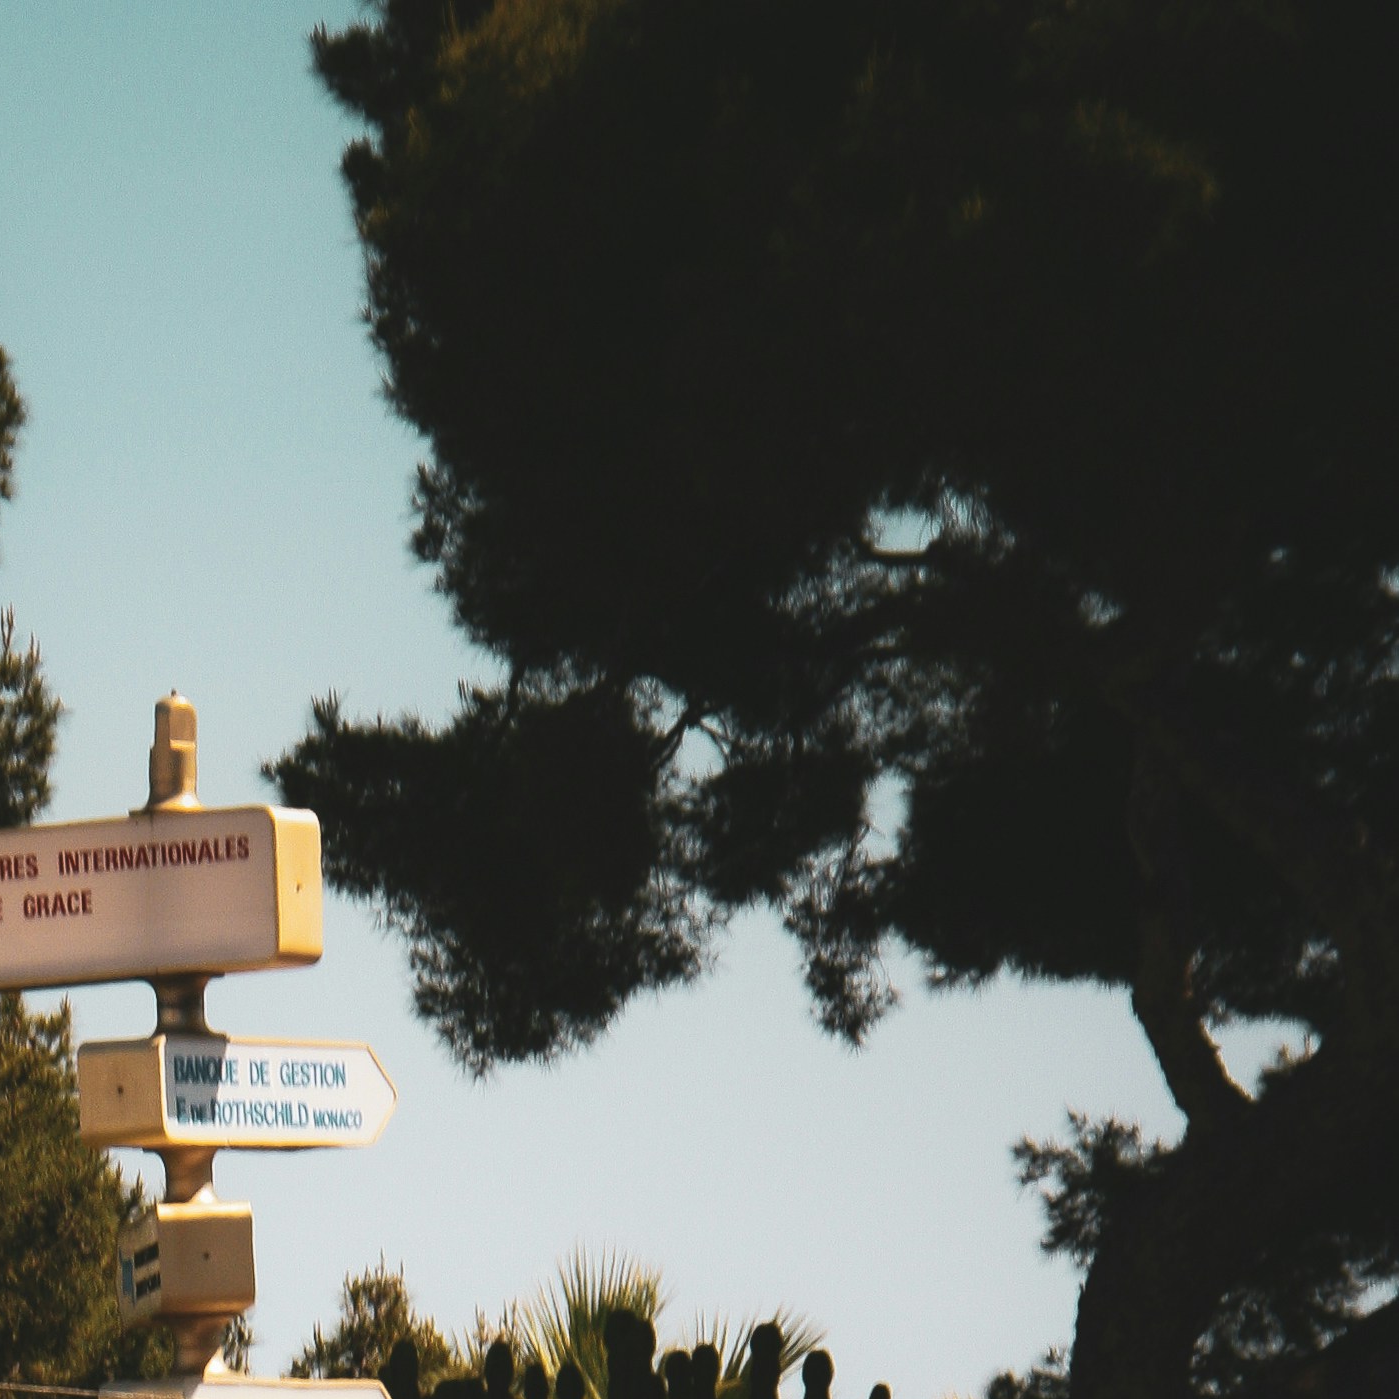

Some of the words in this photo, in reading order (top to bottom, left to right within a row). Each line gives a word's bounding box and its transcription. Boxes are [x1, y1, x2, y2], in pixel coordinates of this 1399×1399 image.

[57, 833, 251, 876] INTERNATIONALES
[23, 889, 93, 920] GRACE
[173, 1055, 239, 1086] BANQUE
[249, 1059, 270, 1087] DE
[279, 1058, 347, 1088] GESTION
[211, 1098, 309, 1128] ROTHSCHILD
[313, 1108, 363, 1130] MONACO
